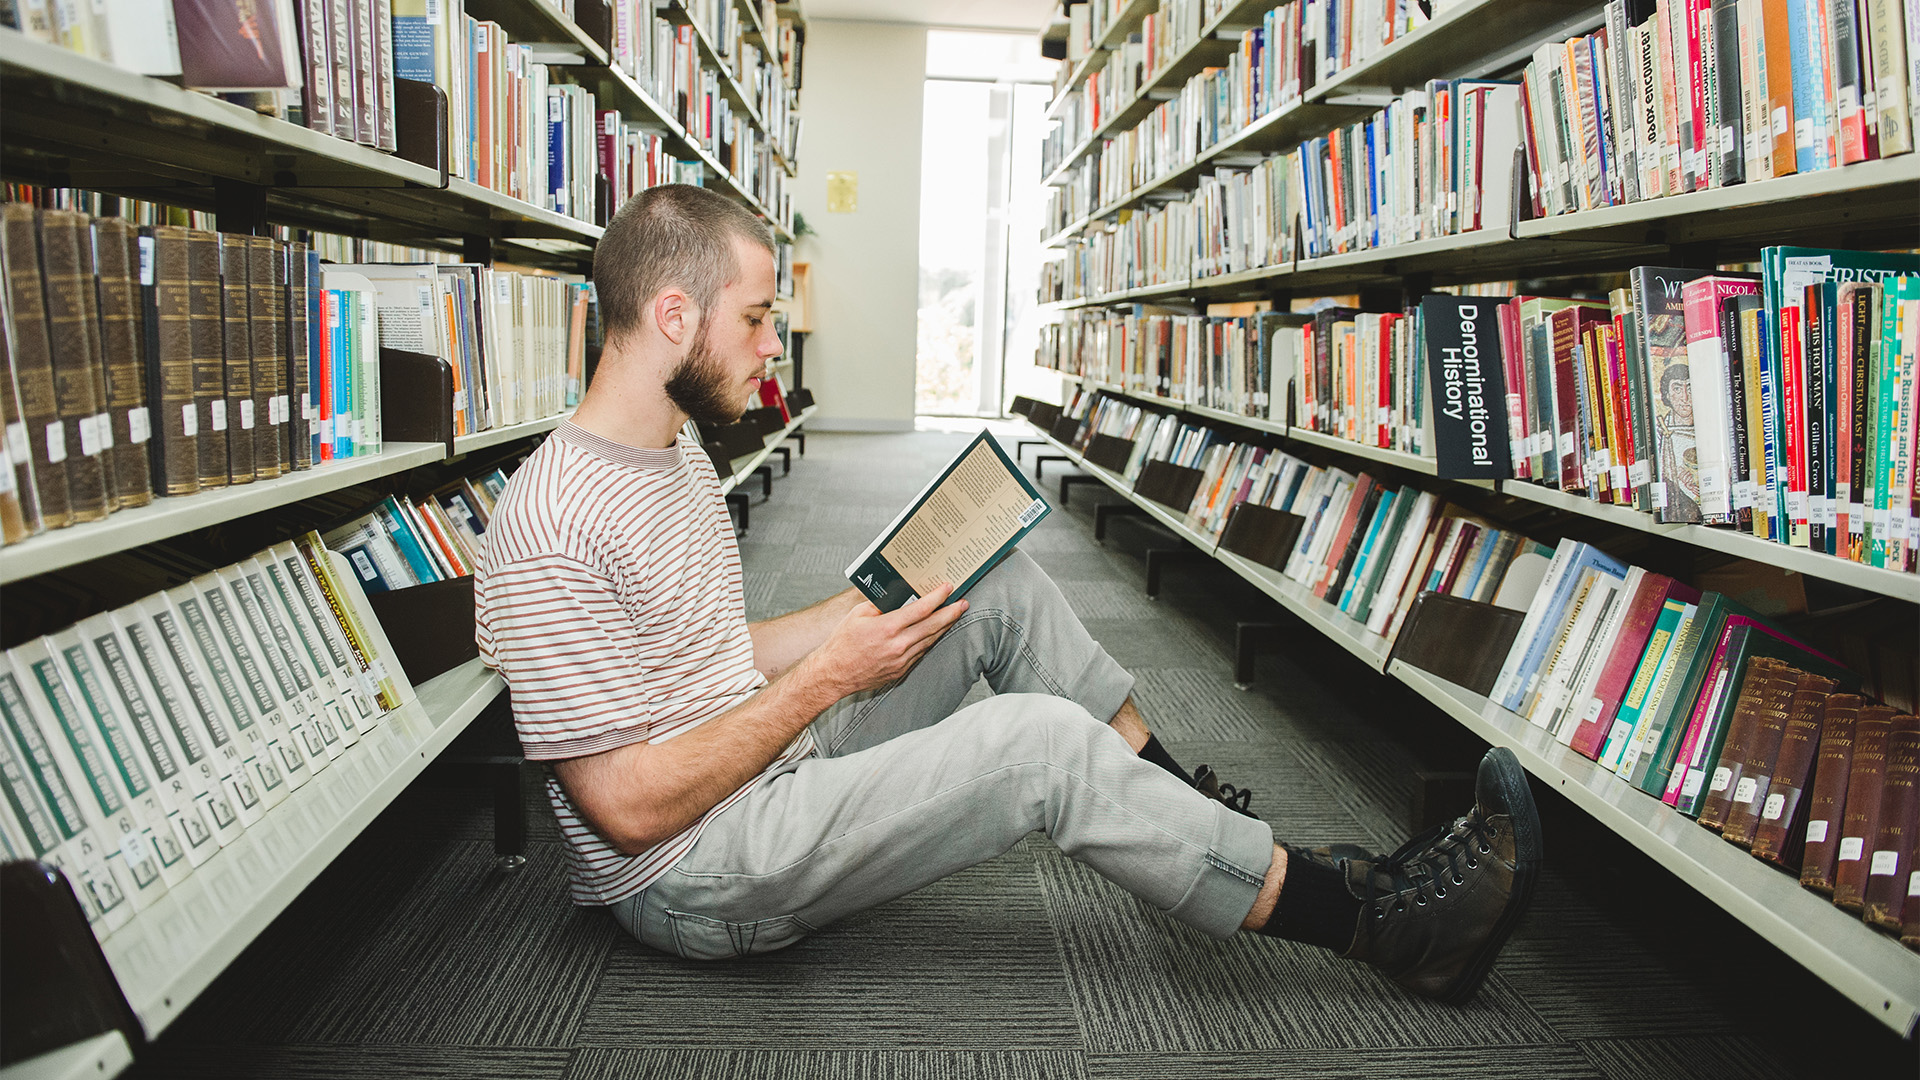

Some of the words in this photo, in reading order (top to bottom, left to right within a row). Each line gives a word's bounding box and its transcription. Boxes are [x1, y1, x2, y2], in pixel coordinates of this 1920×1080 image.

[1795, 6, 1806, 25] THE
[1701, 23, 1711, 89] Reformation
[1797, 26, 1810, 76] CHRISTIAN
[1637, 30, 1657, 103] encounter
[1670, 11, 1683, 83] REFORMATION
[1677, 86, 1687, 120] OVER?
[1822, 263, 1920, 284] HRISTI
[1716, 283, 1764, 297] NICOLAS
[1856, 294, 1866, 324] LIGHT
[1883, 293, 1894, 317] John
[1727, 310, 1737, 353] BOBRINSKOY
[1781, 311, 1789, 328] LIGHT
[1883, 319, 1893, 332] D.
[1595, 329, 1607, 364] Byzantine
[1782, 329, 1790, 355] THROUGH
[1839, 311, 1848, 365] Understanding
[1856, 325, 1865, 344] from
[1812, 347, 1820, 378] HOLY
[1856, 345, 1864, 356] the
[1901, 353, 1913, 372] The
[1600, 363, 1609, 378] East
[1733, 372, 1741, 388] The
[1759, 368, 1770, 389] THE
[1783, 356, 1791, 383] DARKNESS
[1840, 364, 1848, 390] Eastern
[1442, 347, 1464, 420] History
[1458, 304, 1493, 466] Denominational
[1602, 383, 1611, 398] Latin
[1855, 357, 1865, 412] CHRISTIAN
[1604, 398, 1613, 417] West
[1621, 398, 1629, 419] Byzantine
[1629, 390, 1638, 428] ORTHODOX
[1732, 388, 1744, 422] Mystery
[1784, 397, 1792, 422] Orthodox
[1839, 391, 1848, 433] Christianity
[1866, 395, 1875, 423] Meeting
[1880, 391, 1889, 428] LECTURES
[1898, 379, 1912, 433] Russians
[1624, 420, 1632, 440] Tradition
[1736, 422, 1745, 433] of
[1760, 391, 1774, 446] ORTHODOX
[1854, 413, 1863, 439] EAST
[1633, 428, 1641, 454] CHURCH
[1737, 432, 1746, 445] the
[1785, 423, 1793, 448] Tradition
[1810, 421, 1820, 457] Gillian
[1879, 428, 1887, 439] IN
[1896, 434, 1908, 458] and
[1738, 446, 1748, 475] Church
[1865, 434, 1874, 468] Orthodox
[1877, 439, 1887, 481] CHRISTIAN
[1764, 448, 1777, 491] CHURCH
[1811, 459, 1820, 490] Crow
[1891, 540, 1900, 562] SPCK
[1591, 558, 1612, 573] Thomas
[209, 591, 225, 611] THE
[308, 556, 321, 575] THE
[316, 573, 336, 606] DEATH
[332, 604, 342, 617] OF
[337, 615, 356, 646] DEATH
[353, 648, 368, 670] John
[218, 609, 242, 646] WORKS
[1558, 586, 1591, 644] exploding
[101, 637, 119, 661] THE
[235, 644, 248, 659] OF
[1641, 631, 1662, 670] CATHOLIC
[1670, 619, 1691, 659] DYNAMIC
[1649, 640, 1666, 672] CONCISE
[111, 658, 139, 702] WORKS
[241, 656, 260, 683] JOHN
[1710, 660, 1721, 680] Short
[1716, 674, 1724, 686] The
[253, 681, 273, 710] OWEN
[1627, 670, 1645, 703] CHURCH
[1635, 672, 1651, 705] HISTORY
[1649, 657, 1676, 711] CATHOLICISM
[1699, 679, 1714, 705] History
[1709, 687, 1720, 707] Catholic
[130, 699, 146, 716] OF
[269, 713, 282, 726] 12
[291, 702, 305, 716] 13
[1693, 712, 1702, 724] the
[1697, 704, 1705, 713] of
[1702, 708, 1713, 729] Church
[137, 713, 159, 745] JOHN
[246, 730, 259, 743] 11
[1684, 723, 1698, 750] Catholic
[150, 741, 173, 775] OWEN
[222, 746, 235, 760] 10
[200, 763, 211, 778] 9
[172, 780, 183, 793] 8
[143, 798, 154, 809] 7
[119, 816, 131, 834] 6
